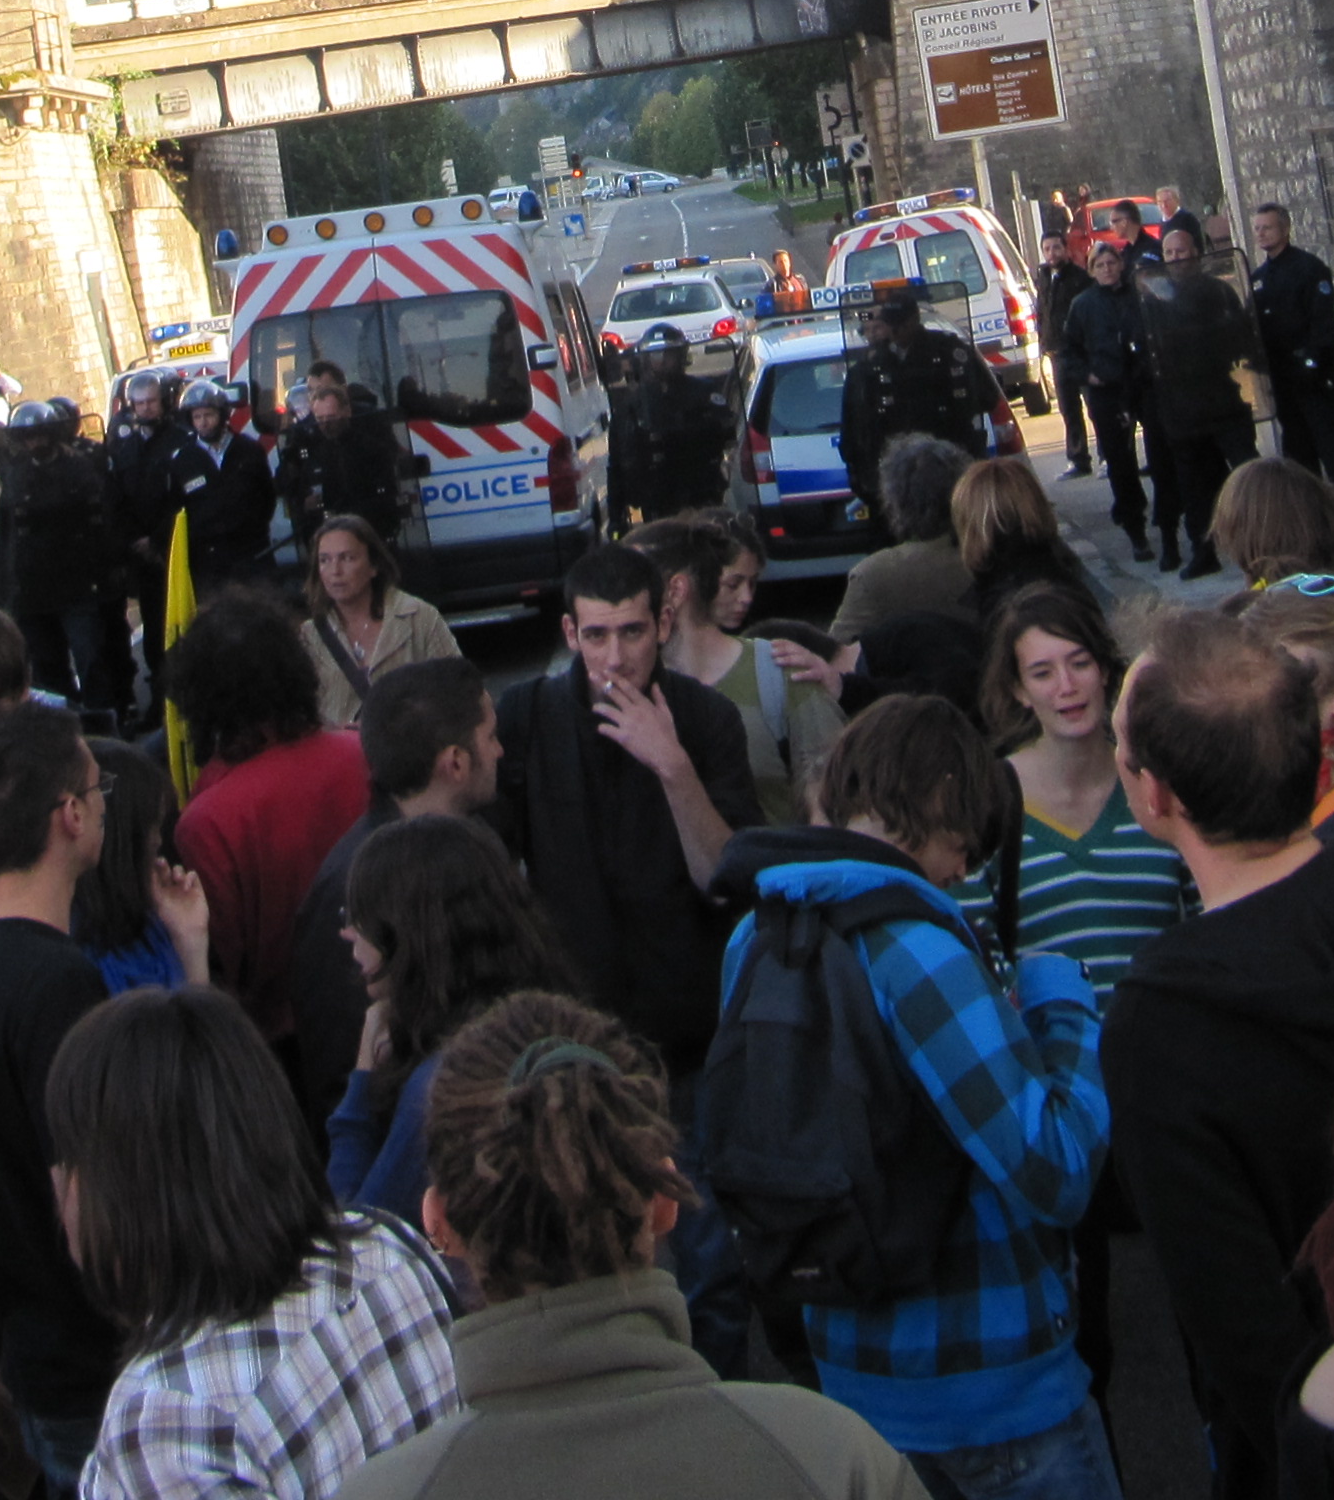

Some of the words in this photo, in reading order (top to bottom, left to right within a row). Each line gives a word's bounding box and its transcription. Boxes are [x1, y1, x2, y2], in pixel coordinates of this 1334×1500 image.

[920, 10, 967, 26] ENTRÉE
[971, 2, 1023, 18] RIVOTTE
[939, 21, 998, 38] JACOBINS
[924, 41, 961, 53] Conseil
[962, 34, 1005, 47] Régional
[959, 83, 991, 96] HÔTELS
[898, 198, 927, 212] POLICE
[196, 320, 228, 331] POLICE
[169, 342, 211, 357] POLICE
[422, 474, 530, 506] POLICE
